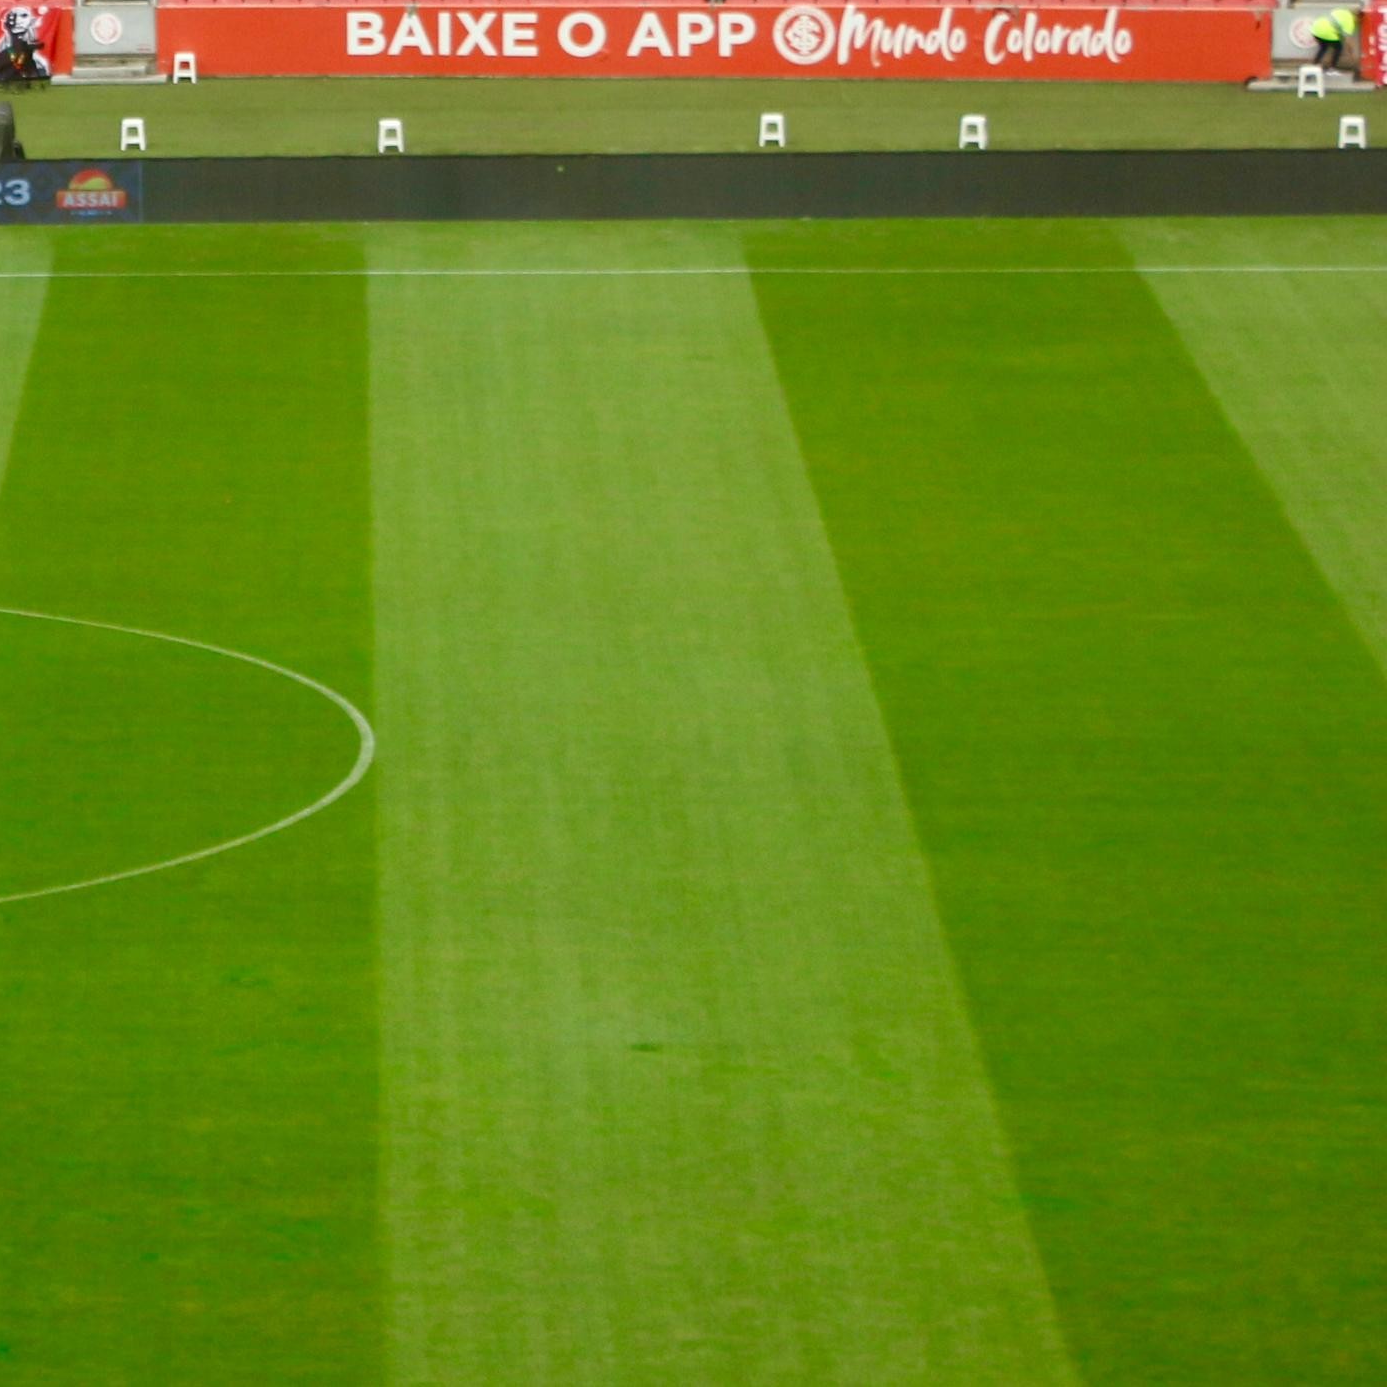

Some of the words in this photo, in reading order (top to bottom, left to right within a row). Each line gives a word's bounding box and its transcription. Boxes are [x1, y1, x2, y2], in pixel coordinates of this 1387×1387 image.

[346, 12, 539, 57] BAIXE
[557, 11, 607, 58] O
[627, 12, 757, 57] APP
[837, 4, 967, 68] Mundo
[983, 6, 1132, 65] Colorado
